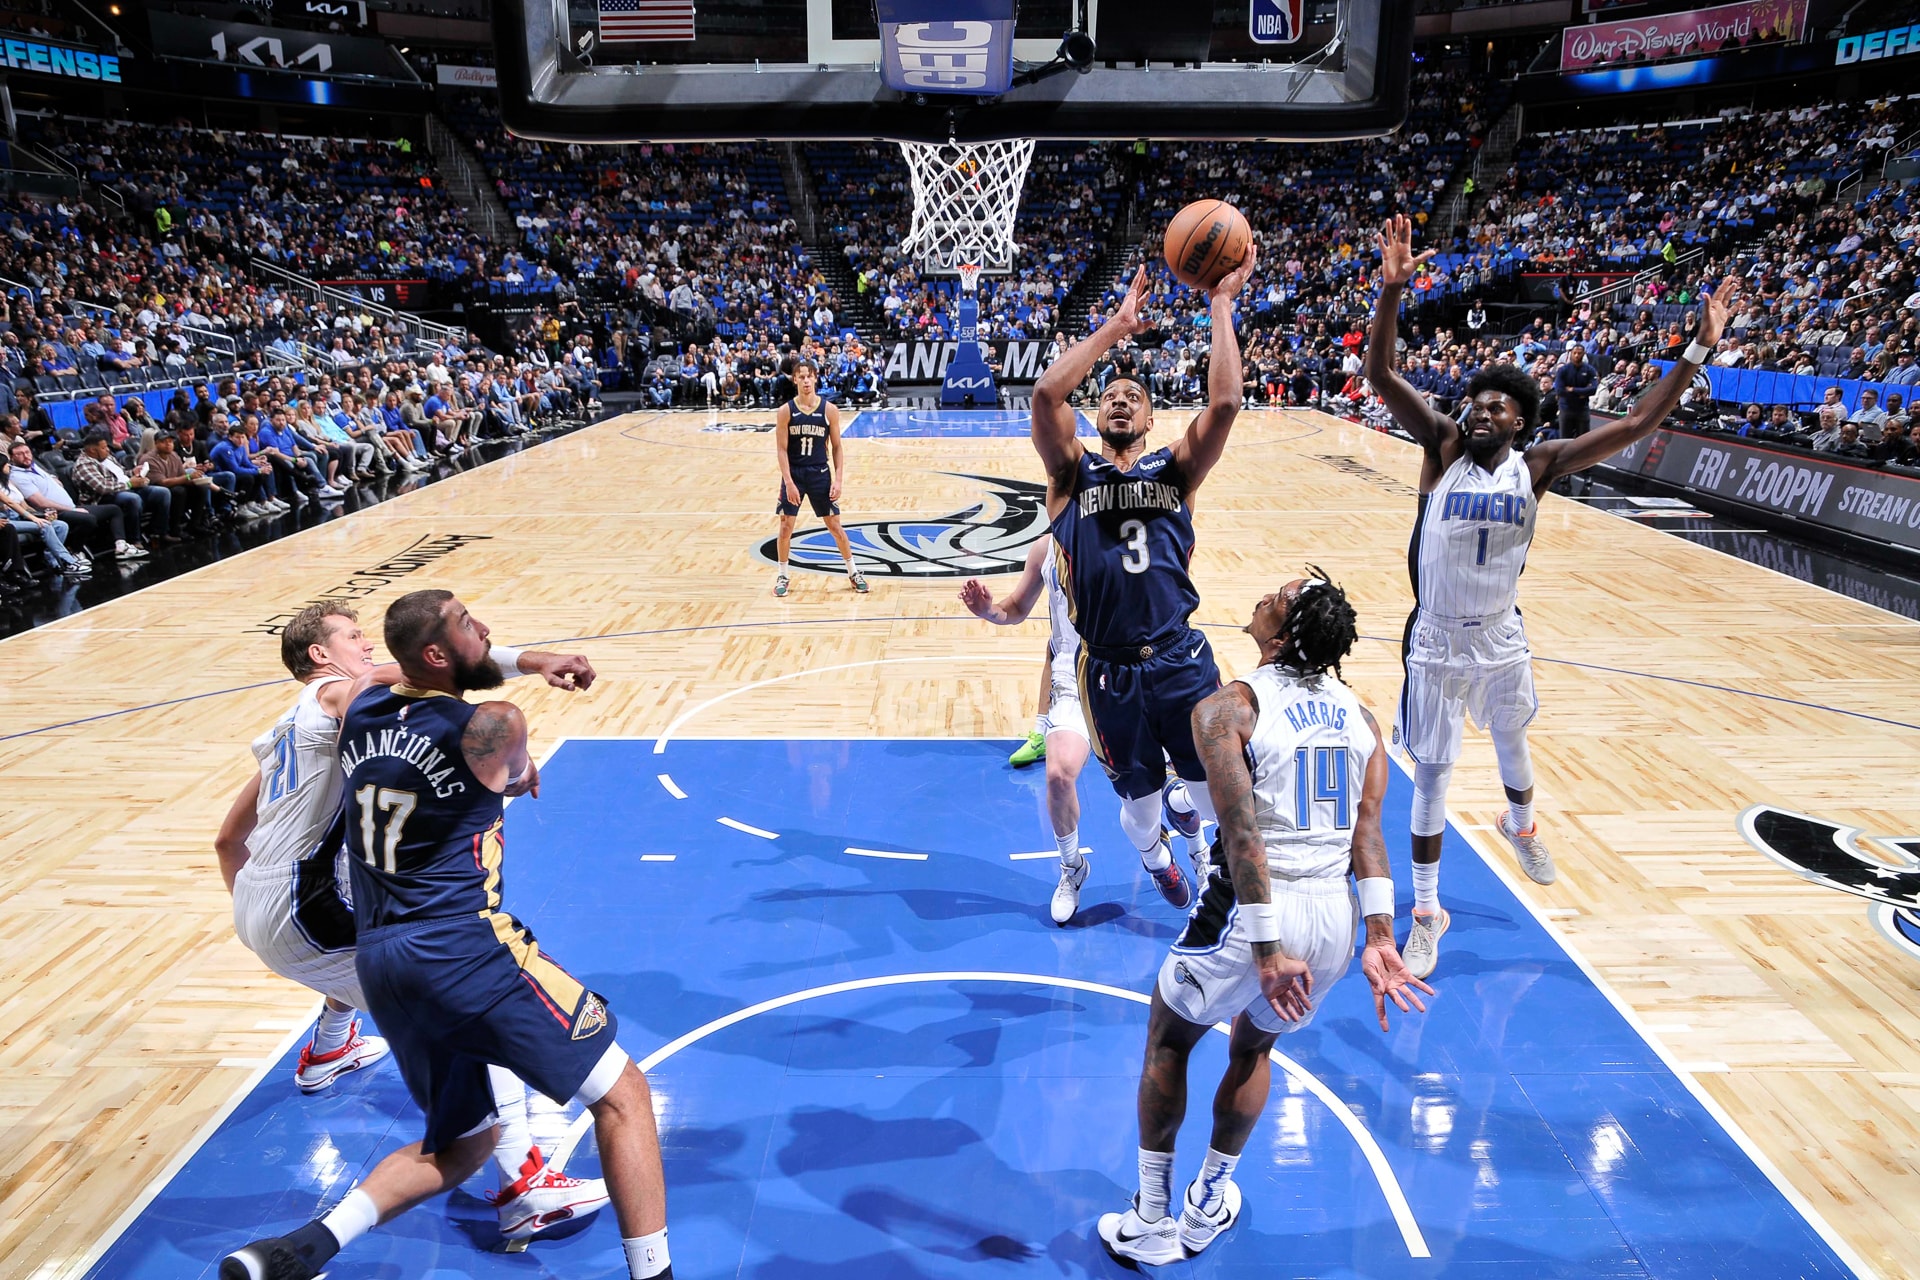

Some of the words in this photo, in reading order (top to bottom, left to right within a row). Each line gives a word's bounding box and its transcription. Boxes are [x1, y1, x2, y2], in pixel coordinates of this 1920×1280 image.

[1257, 14, 1282, 35] NBA
[0, 38, 122, 83] FENSE
[370, 287, 386, 301] VS
[800, 437, 814, 456] 11
[1079, 484, 1115, 519] NEW
[1118, 481, 1181, 513] ORLEANS
[1689, 447, 1731, 490] FRI
[1736, 457, 1835, 517] 7:00PM
[1838, 486, 1911, 525] STREAM
[1441, 491, 1527, 527] MAGIC
[1120, 518, 1150, 574] 3
[1476, 528, 1489, 565] 1
[1284, 700, 1347, 733] HARRIS
[268, 725, 299, 804] 21
[1294, 746, 1350, 831] 14
[355, 783, 417, 875] 17
